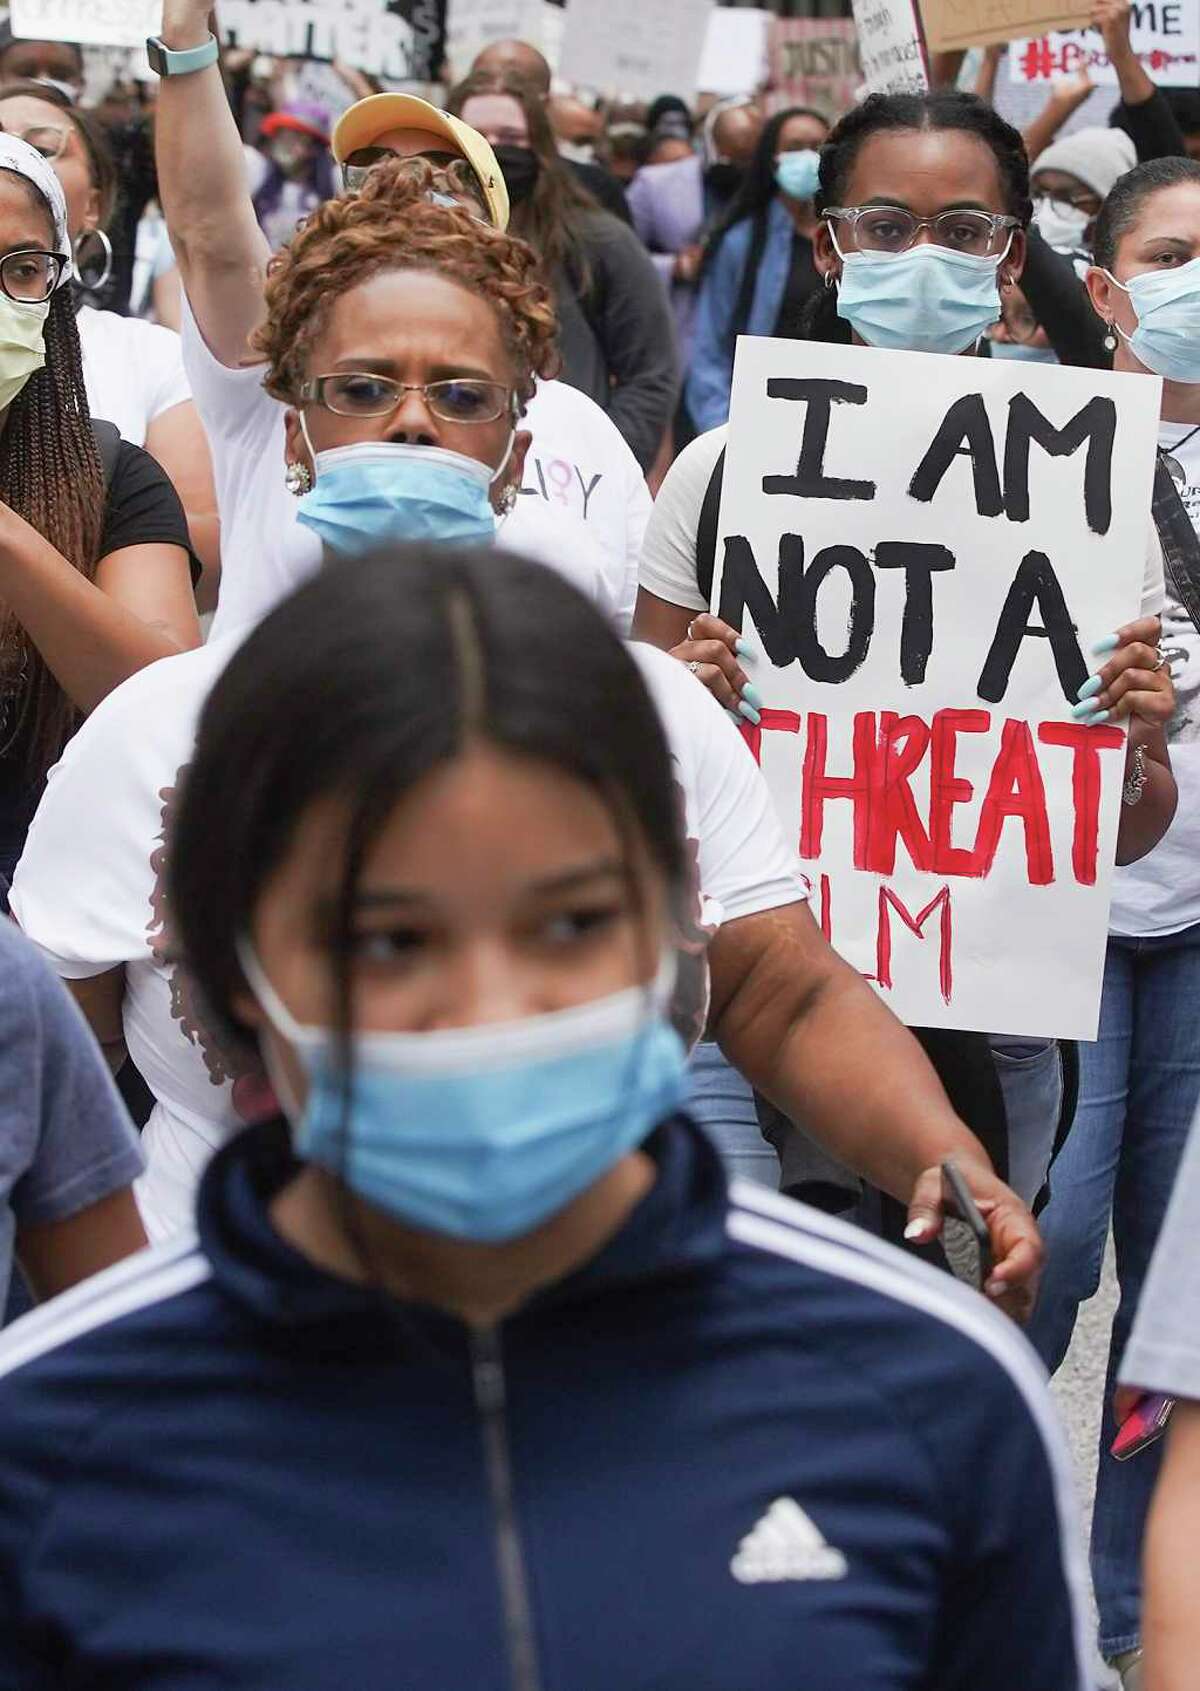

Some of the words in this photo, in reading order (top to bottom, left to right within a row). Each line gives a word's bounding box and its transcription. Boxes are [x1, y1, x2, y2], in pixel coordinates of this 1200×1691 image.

[762, 378, 877, 500] I
[908, 391, 1117, 536] AM
[717, 533, 956, 688] NOT
[977, 550, 1094, 703] A
[741, 708, 1126, 886] THREAT
[800, 873, 952, 1007] LM
